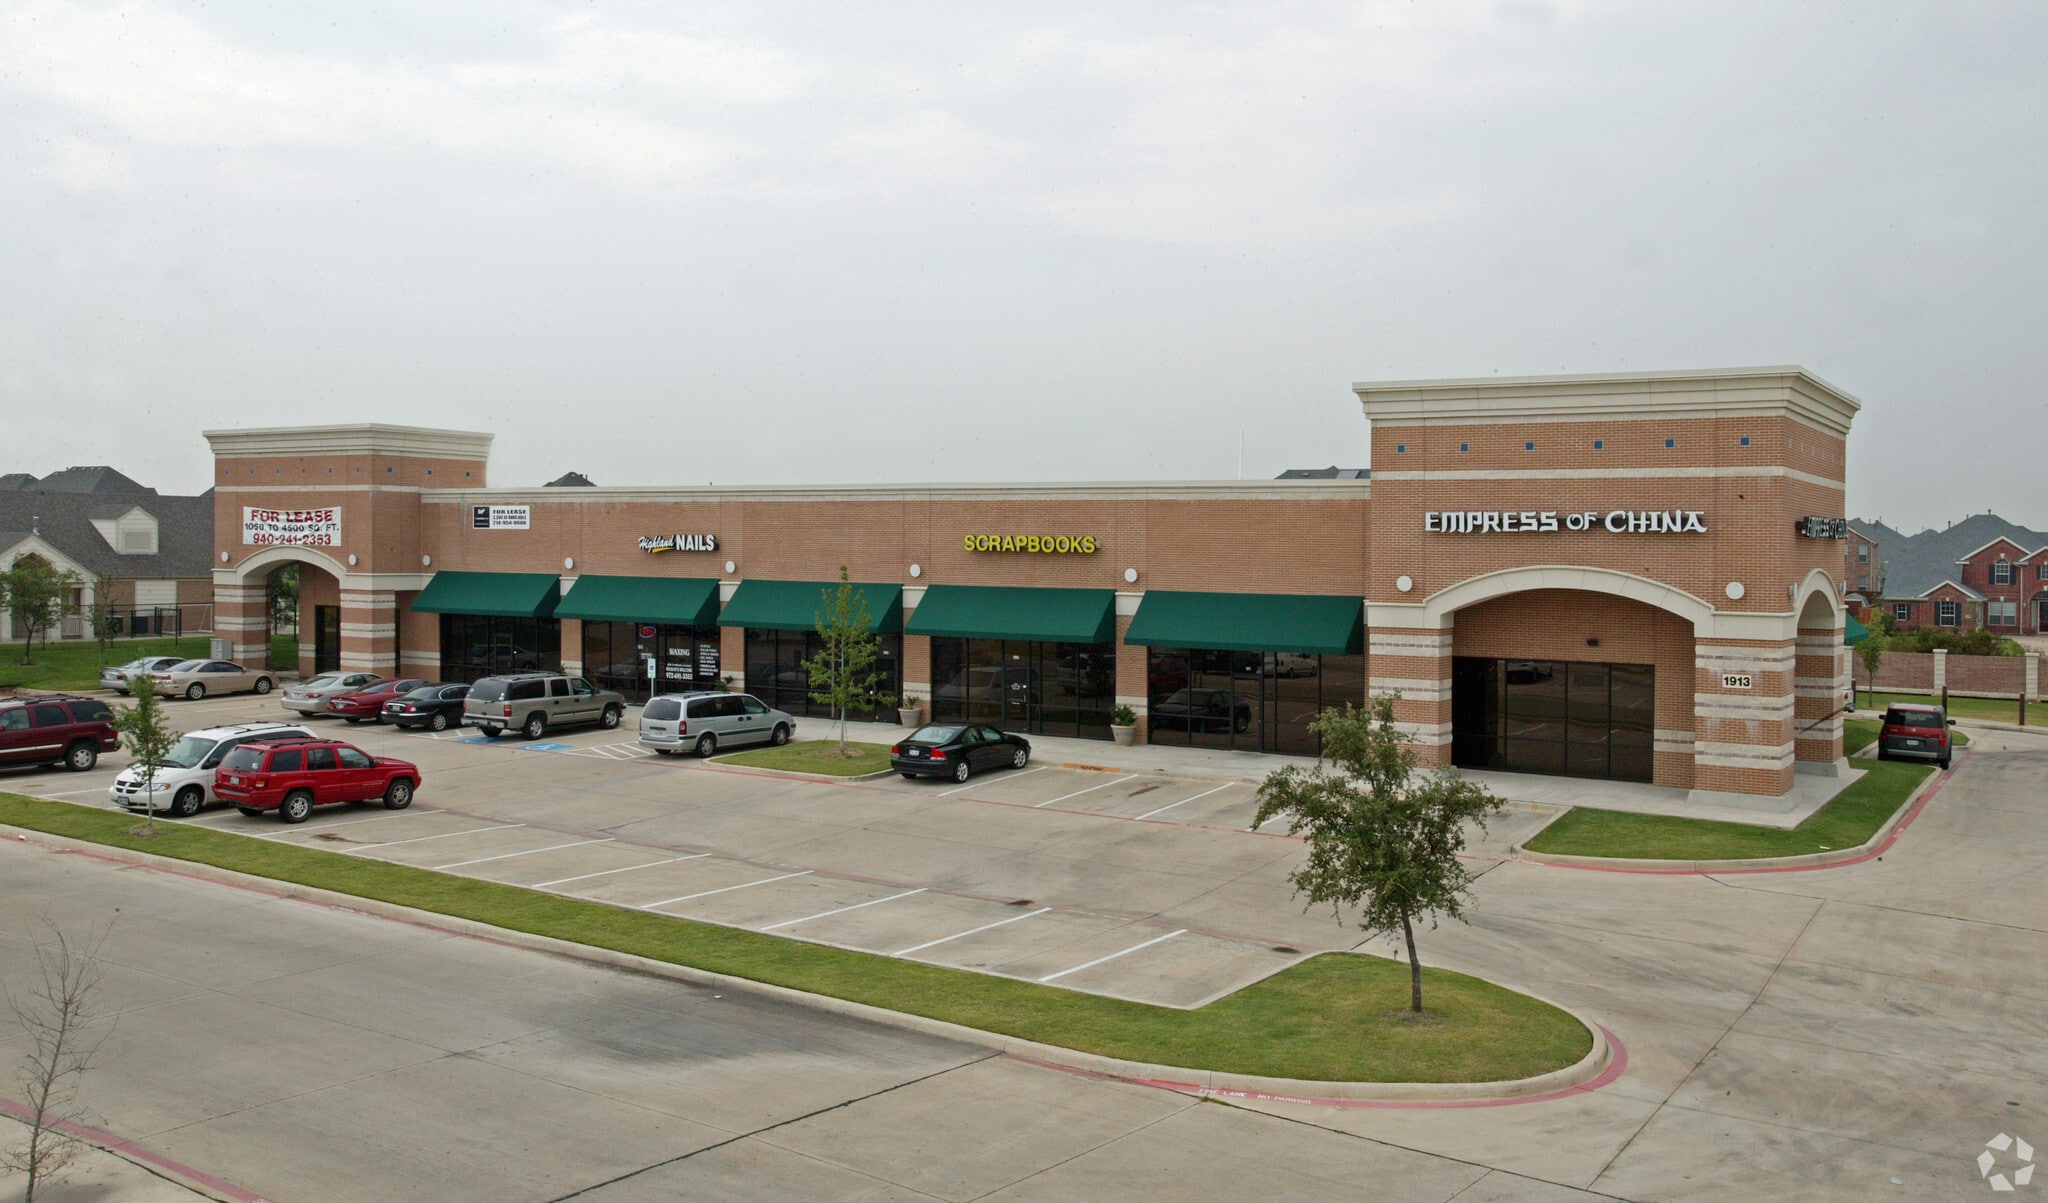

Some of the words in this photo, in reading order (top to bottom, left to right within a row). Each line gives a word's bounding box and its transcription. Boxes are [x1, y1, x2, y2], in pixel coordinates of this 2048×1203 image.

[251, 509, 280, 522] FOR
[285, 509, 333, 522] LEASE
[1424, 510, 1559, 534] EMPRESS
[1565, 511, 1599, 531] OF
[1605, 509, 1708, 534] CHINA
[245, 523, 264, 531] 1050
[267, 523, 279, 532] TO
[281, 524, 305, 532] 4500
[676, 534, 716, 551] NAILS
[964, 534, 1096, 554] SCRAPBOOKS
[669, 648, 690, 656] WAXING
[1724, 676, 1750, 687] 1913
[1223, 1090, 1248, 1098] LANE
